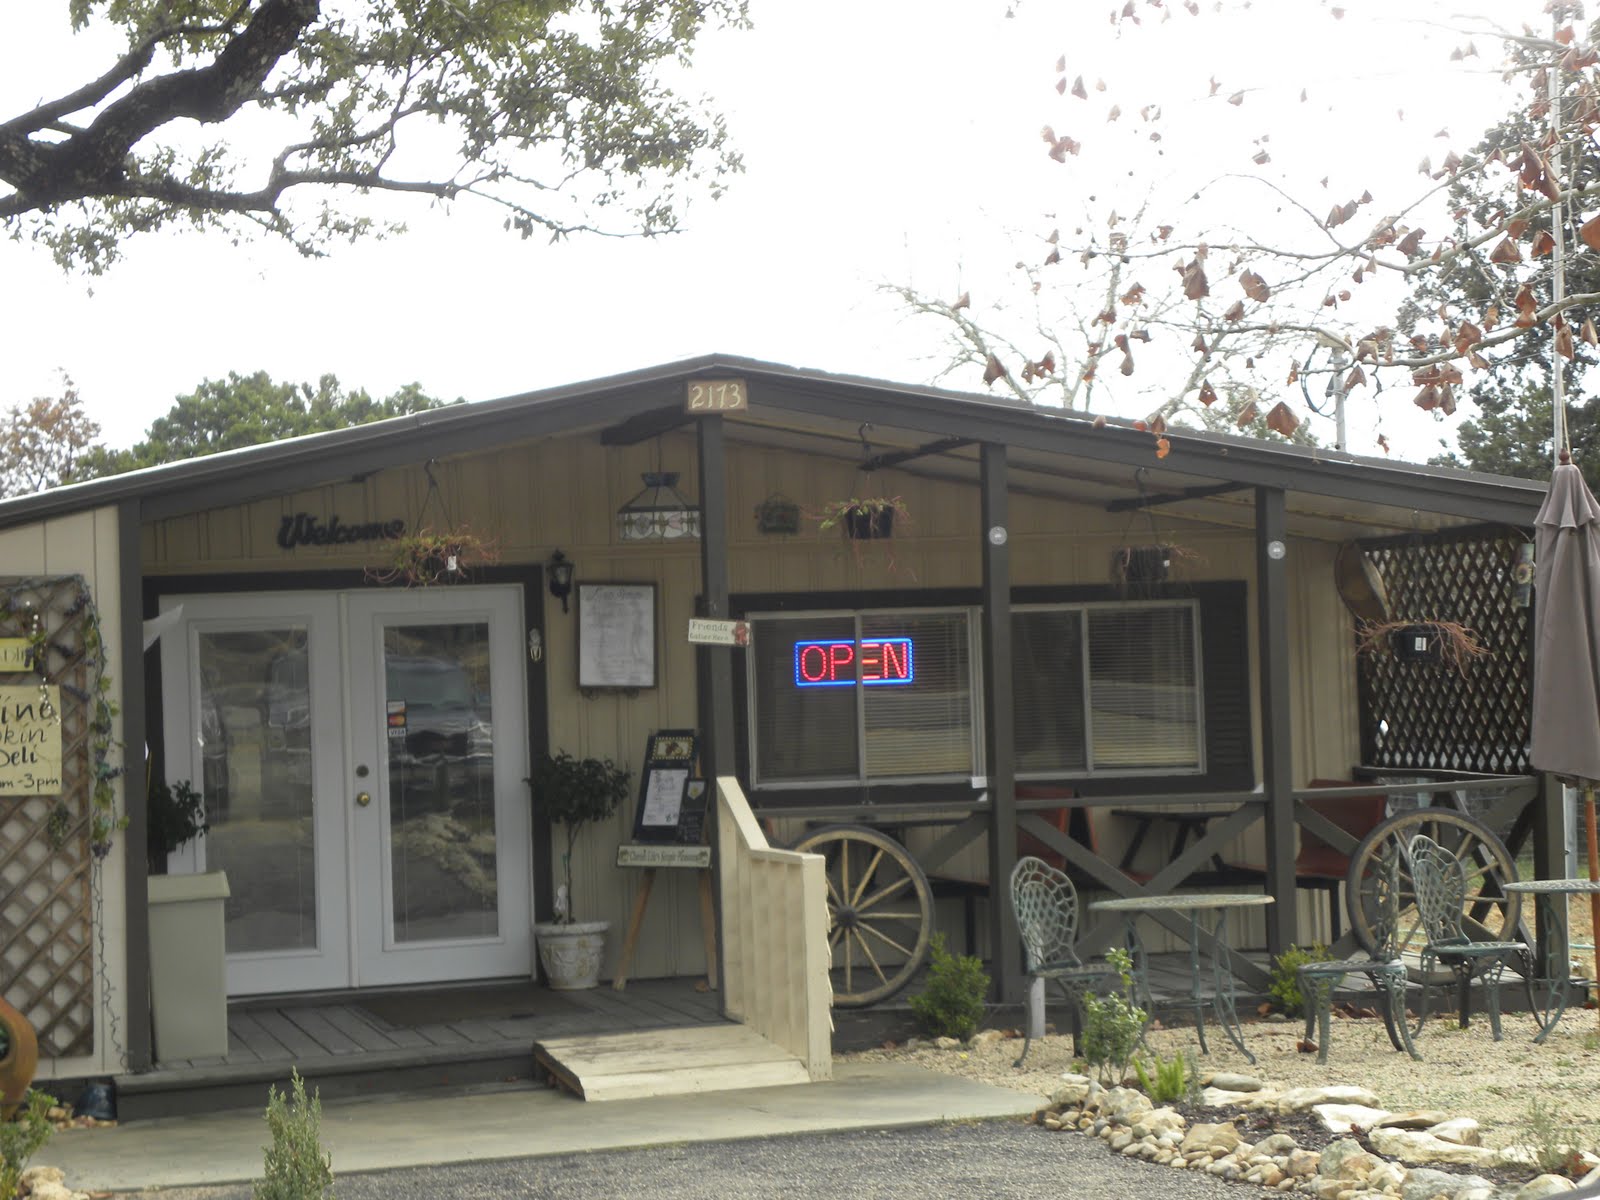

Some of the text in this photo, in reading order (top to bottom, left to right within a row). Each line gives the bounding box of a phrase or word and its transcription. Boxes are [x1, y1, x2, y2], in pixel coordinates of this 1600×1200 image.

[692, 384, 740, 408] 2173
[277, 512, 406, 549] Welcome
[691, 621, 728, 632] Friends
[801, 643, 907, 681] OPEN
[0, 695, 57, 724] ine
